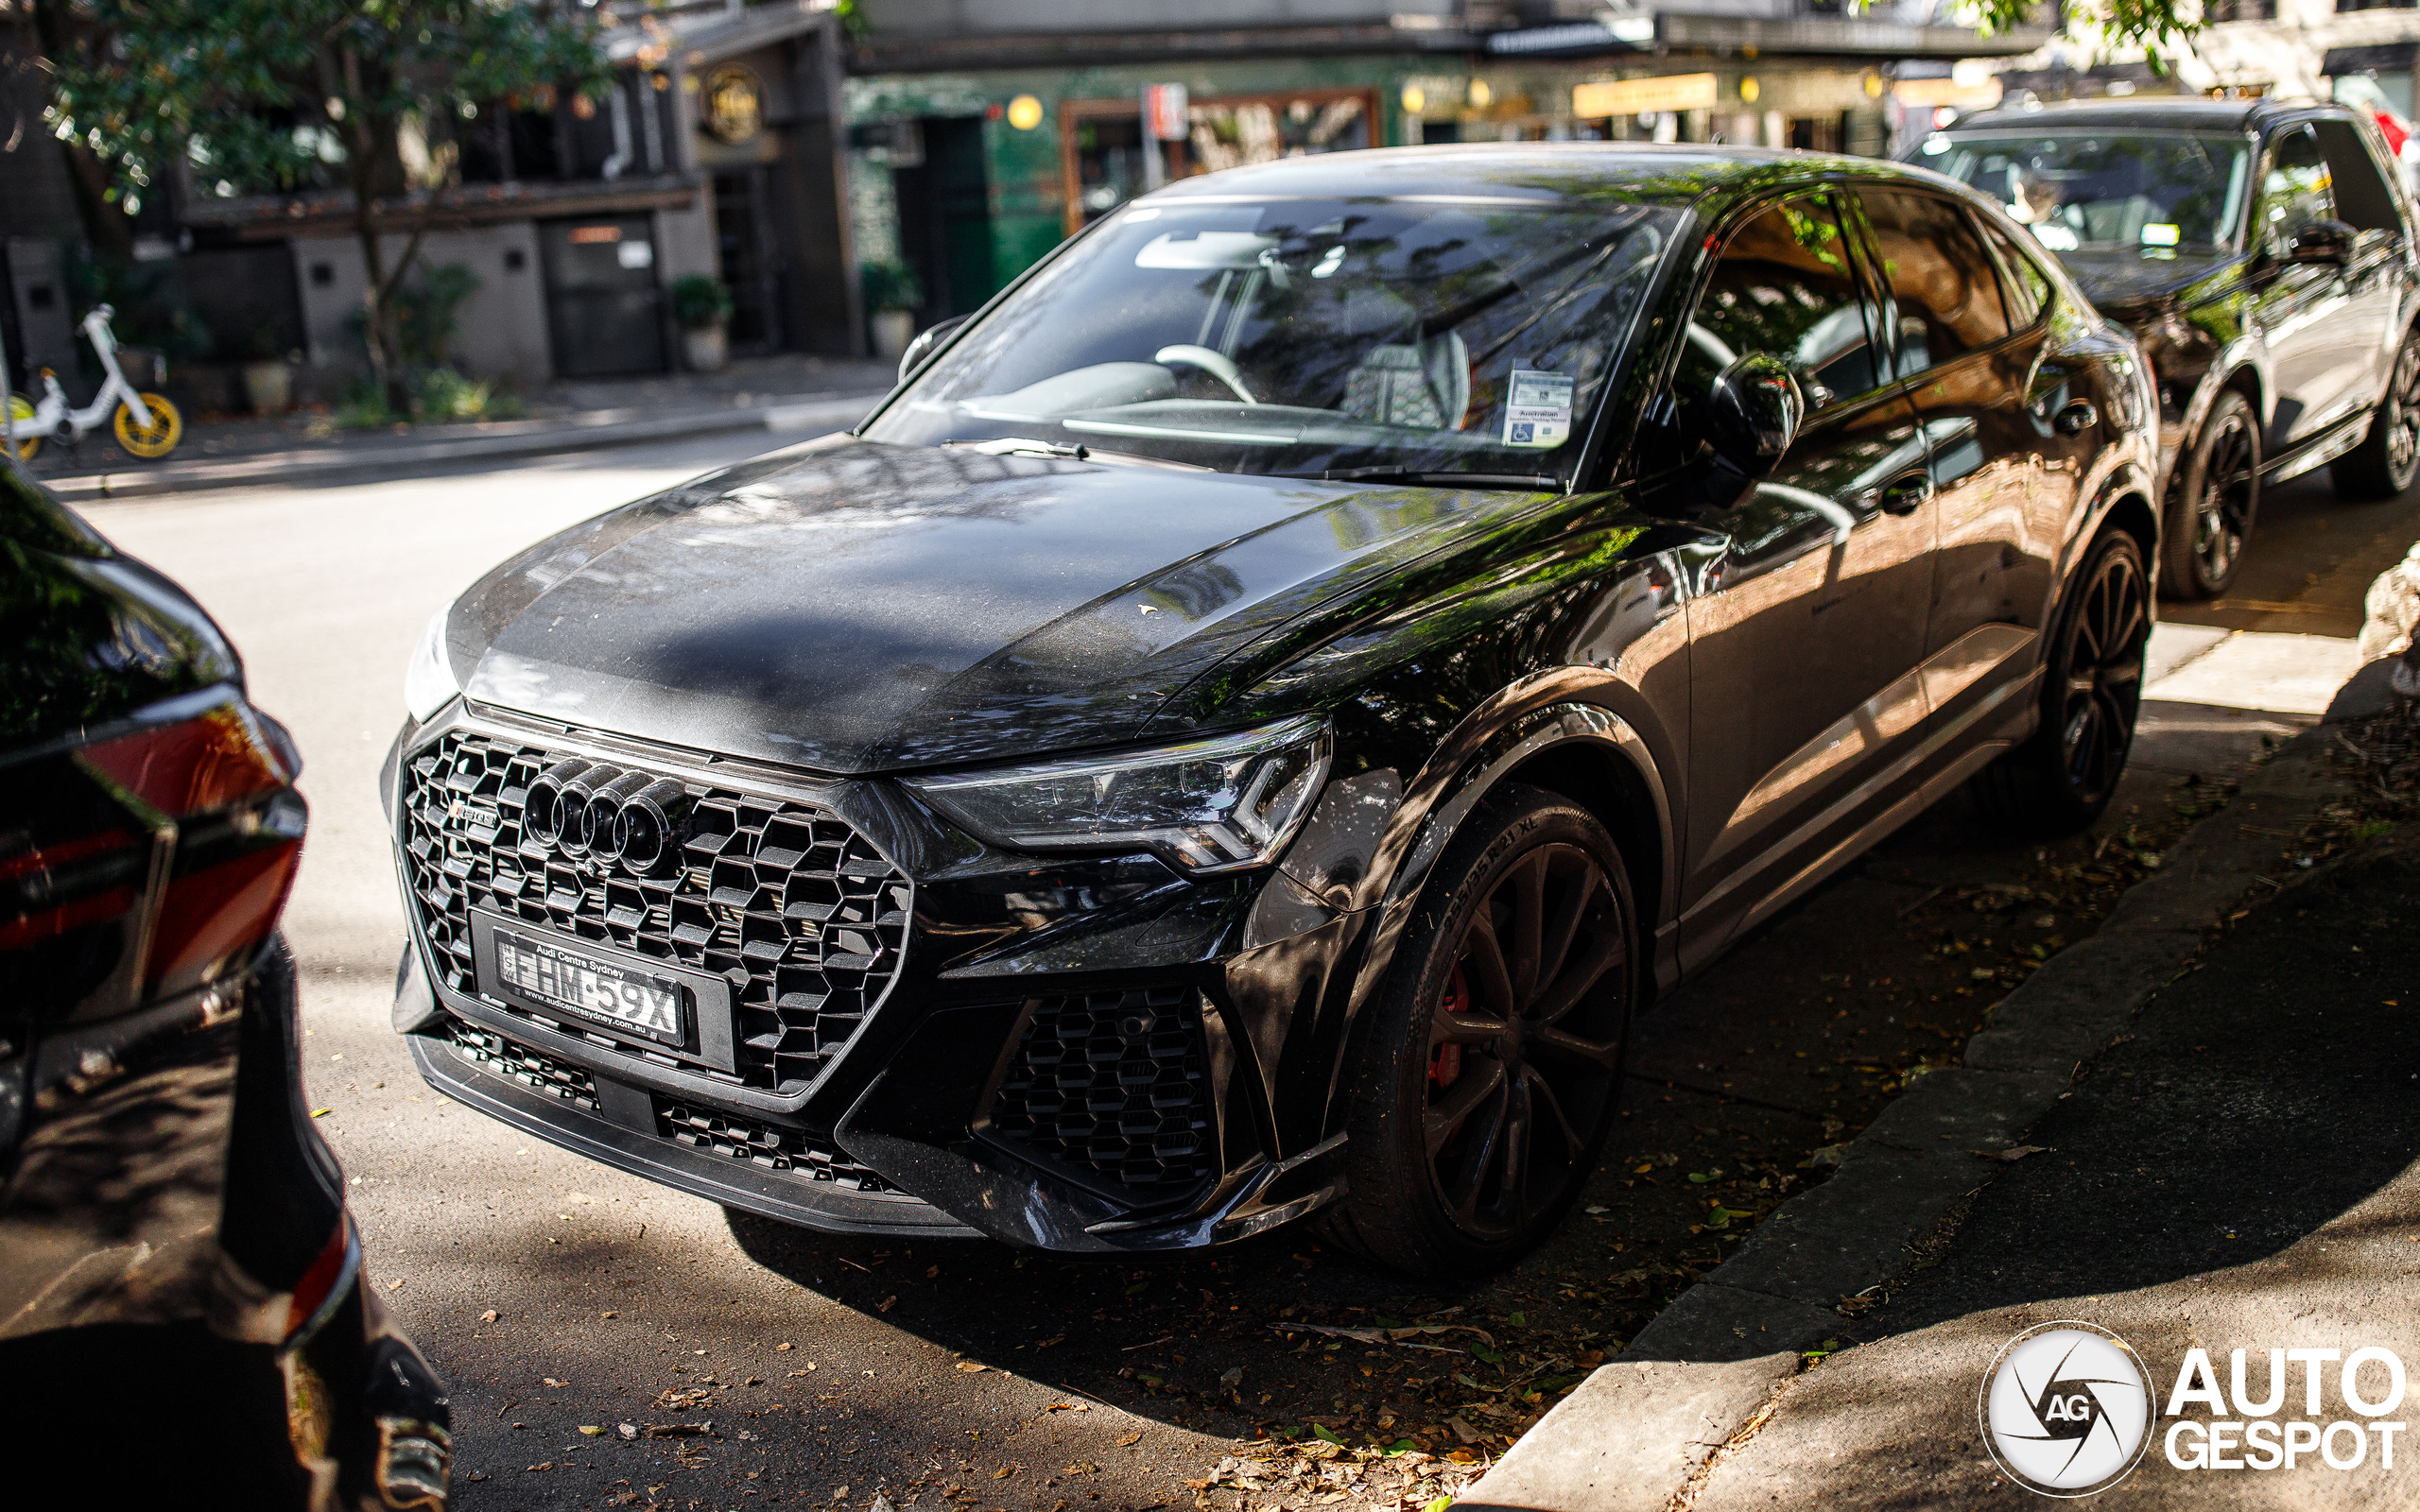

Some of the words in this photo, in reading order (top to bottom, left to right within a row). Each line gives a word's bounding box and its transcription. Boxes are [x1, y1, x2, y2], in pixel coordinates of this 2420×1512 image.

[1488, 850, 1500, 865] R
[1499, 830, 1516, 850] 21
[1518, 817, 1538, 835] XL
[536, 945, 557, 958] Audi
[558, 950, 588, 969] Centre
[589, 960, 625, 980] Sydney
[524, 988, 646, 1033] www.audicentresydney.com.au
